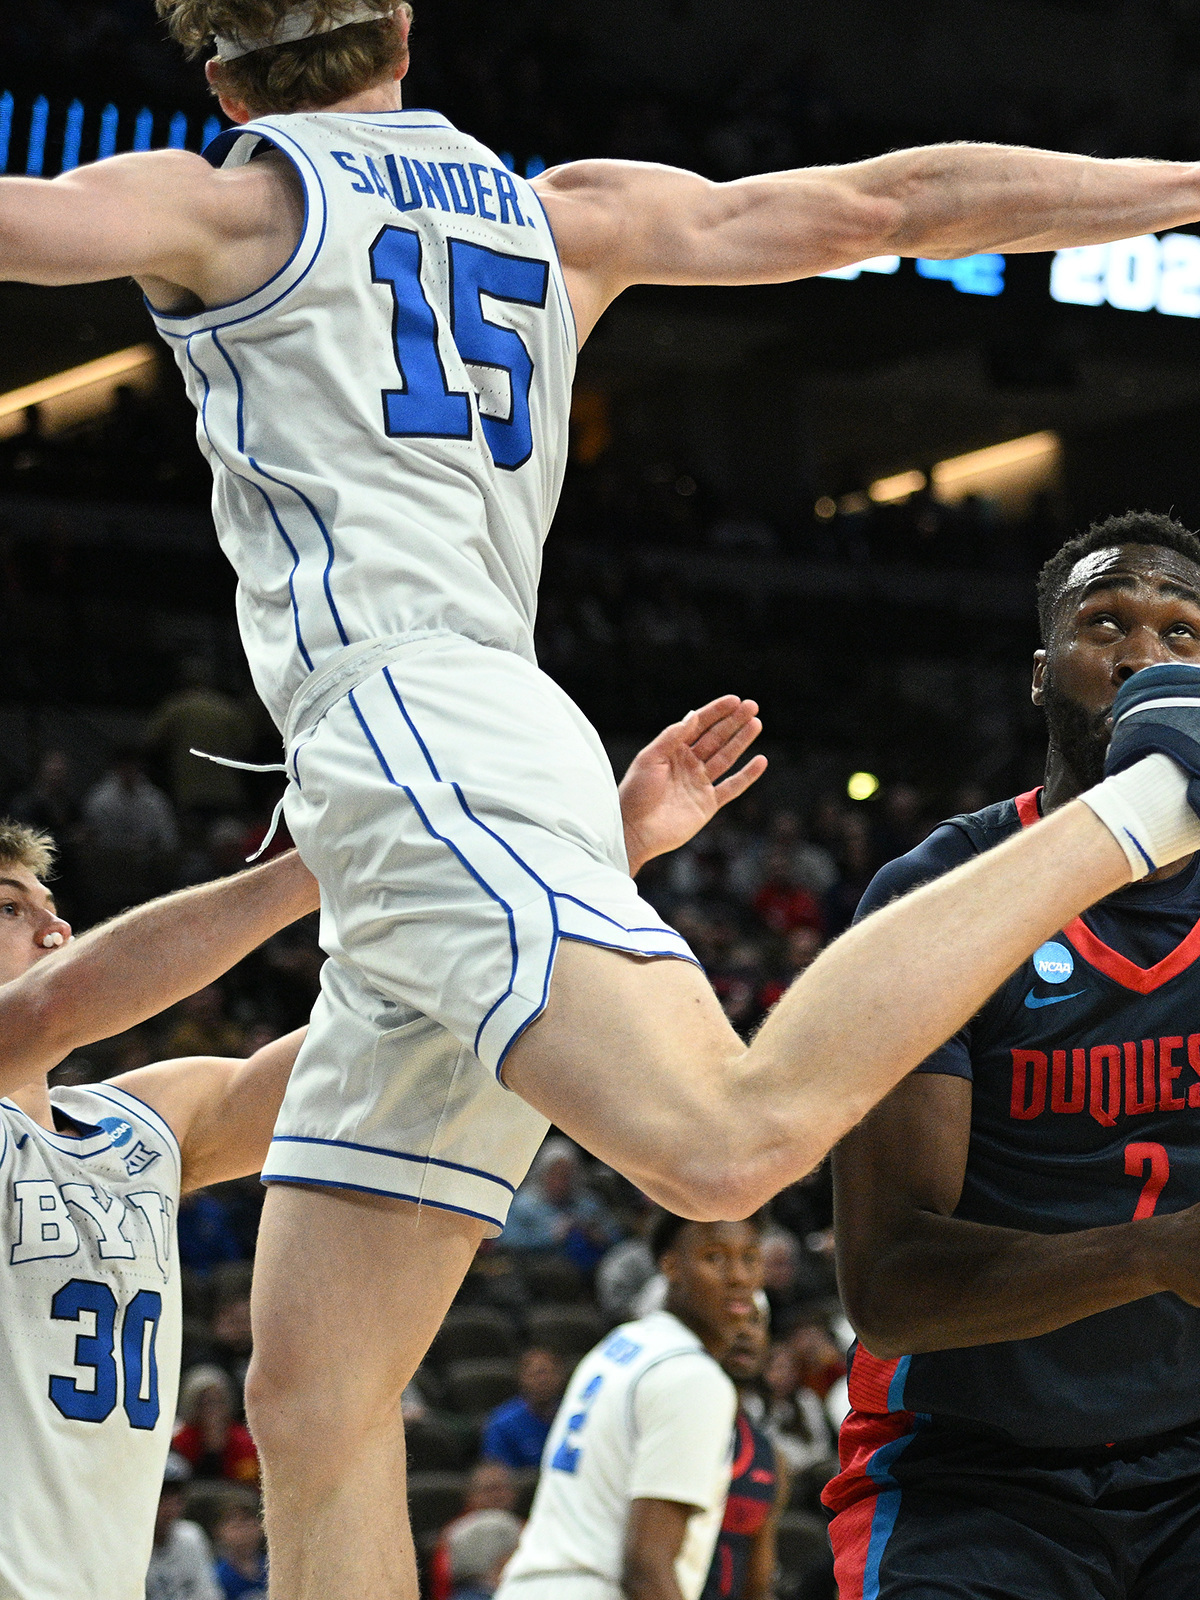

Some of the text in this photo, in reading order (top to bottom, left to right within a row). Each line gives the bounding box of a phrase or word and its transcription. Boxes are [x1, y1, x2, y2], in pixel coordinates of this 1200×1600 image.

[330, 150, 537, 229] SAUNDER
[369, 223, 550, 472] 15
[1038, 960, 1072, 974] NCAA
[10, 1179, 174, 1280] BYU
[48, 1278, 162, 1431] 30
[552, 1375, 603, 1475] 2
